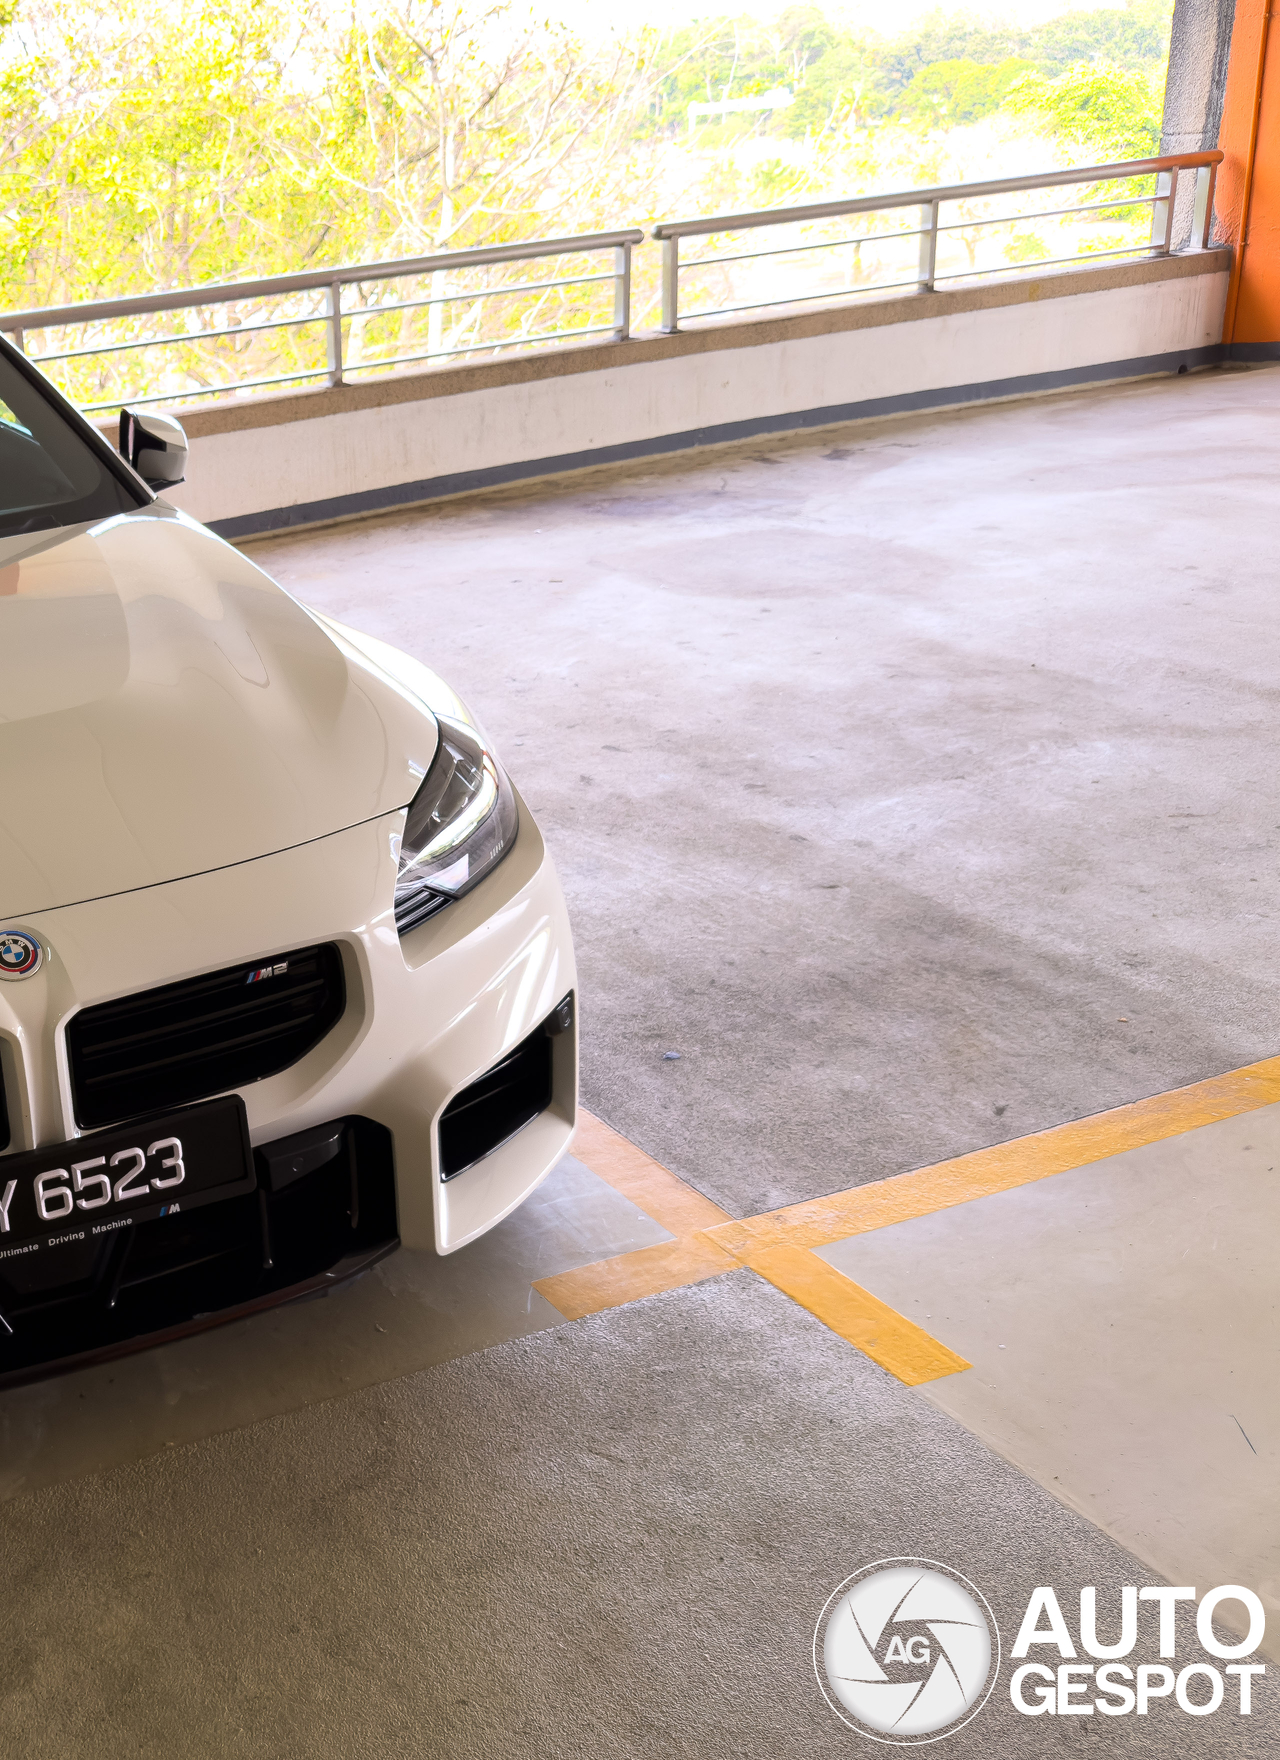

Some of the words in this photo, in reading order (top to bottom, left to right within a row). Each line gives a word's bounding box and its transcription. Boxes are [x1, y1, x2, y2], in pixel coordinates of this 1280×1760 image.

[259, 961, 289, 980] M2
[33, 1137, 186, 1221] 6523
[48, 1231, 85, 1246] Driving
[92, 1218, 133, 1234] Machine
